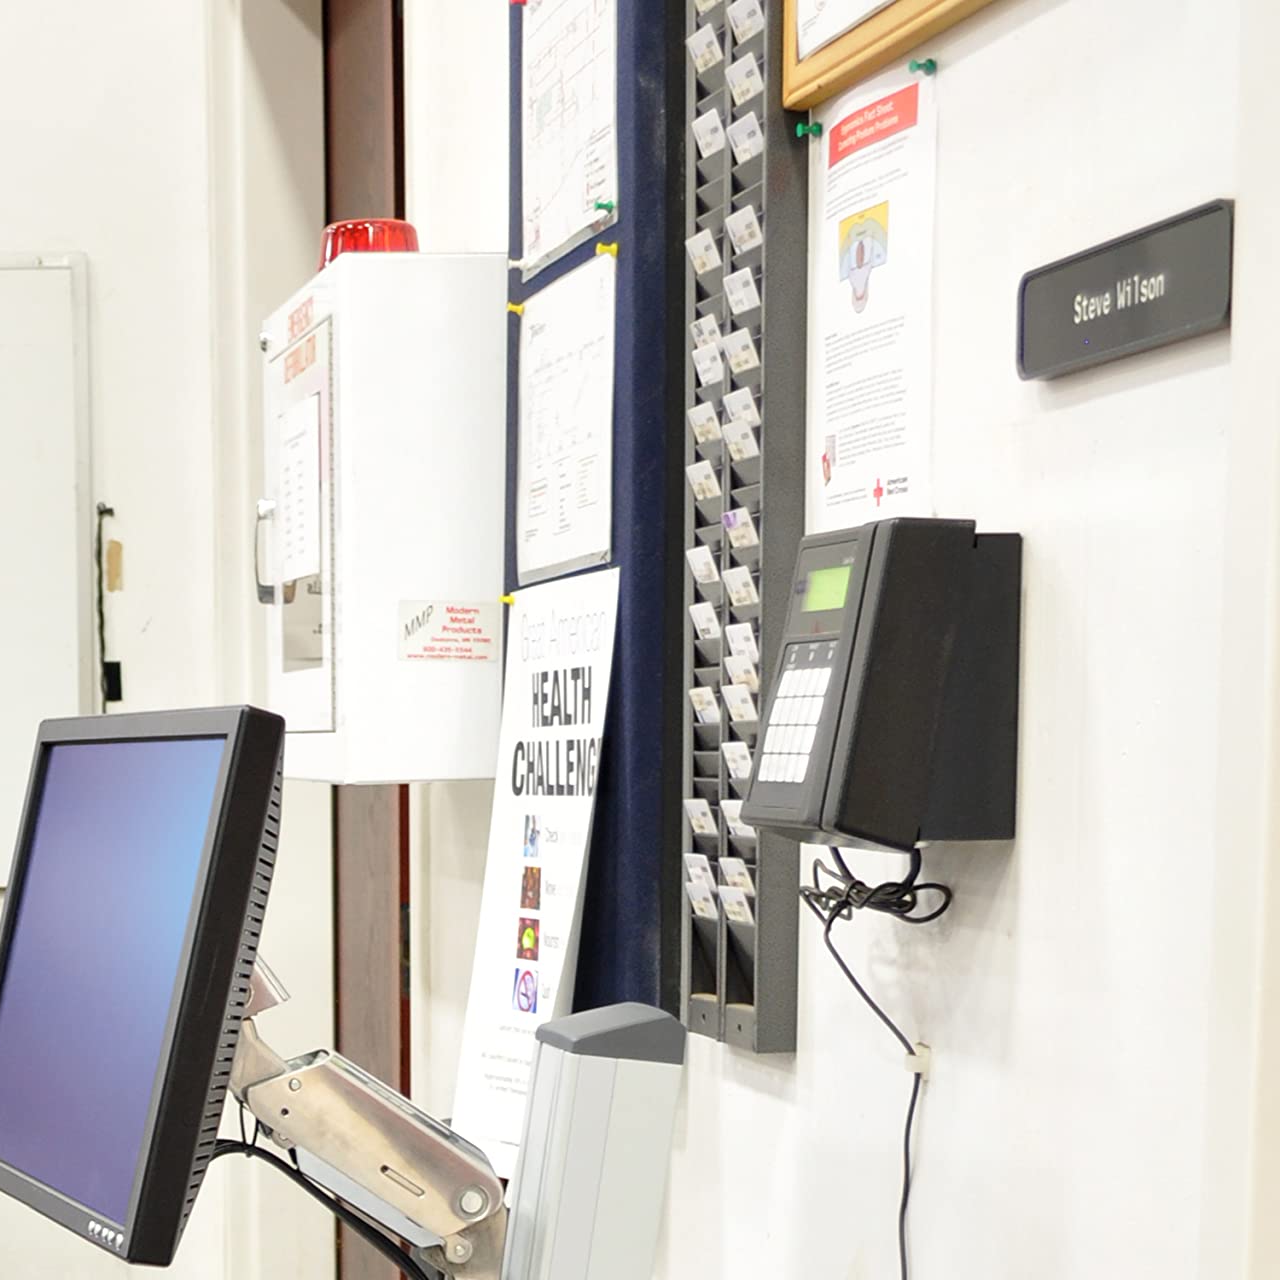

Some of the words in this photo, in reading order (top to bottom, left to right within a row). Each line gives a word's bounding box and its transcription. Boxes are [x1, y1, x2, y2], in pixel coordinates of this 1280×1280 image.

[1073, 293, 1112, 325] Steve
[1116, 273, 1165, 311] Wilson
[403, 604, 434, 640] MMP
[445, 605, 481, 616] Modern
[449, 616, 476, 625] Metal
[441, 625, 483, 635] Products
[532, 665, 592, 728] HEALTH
